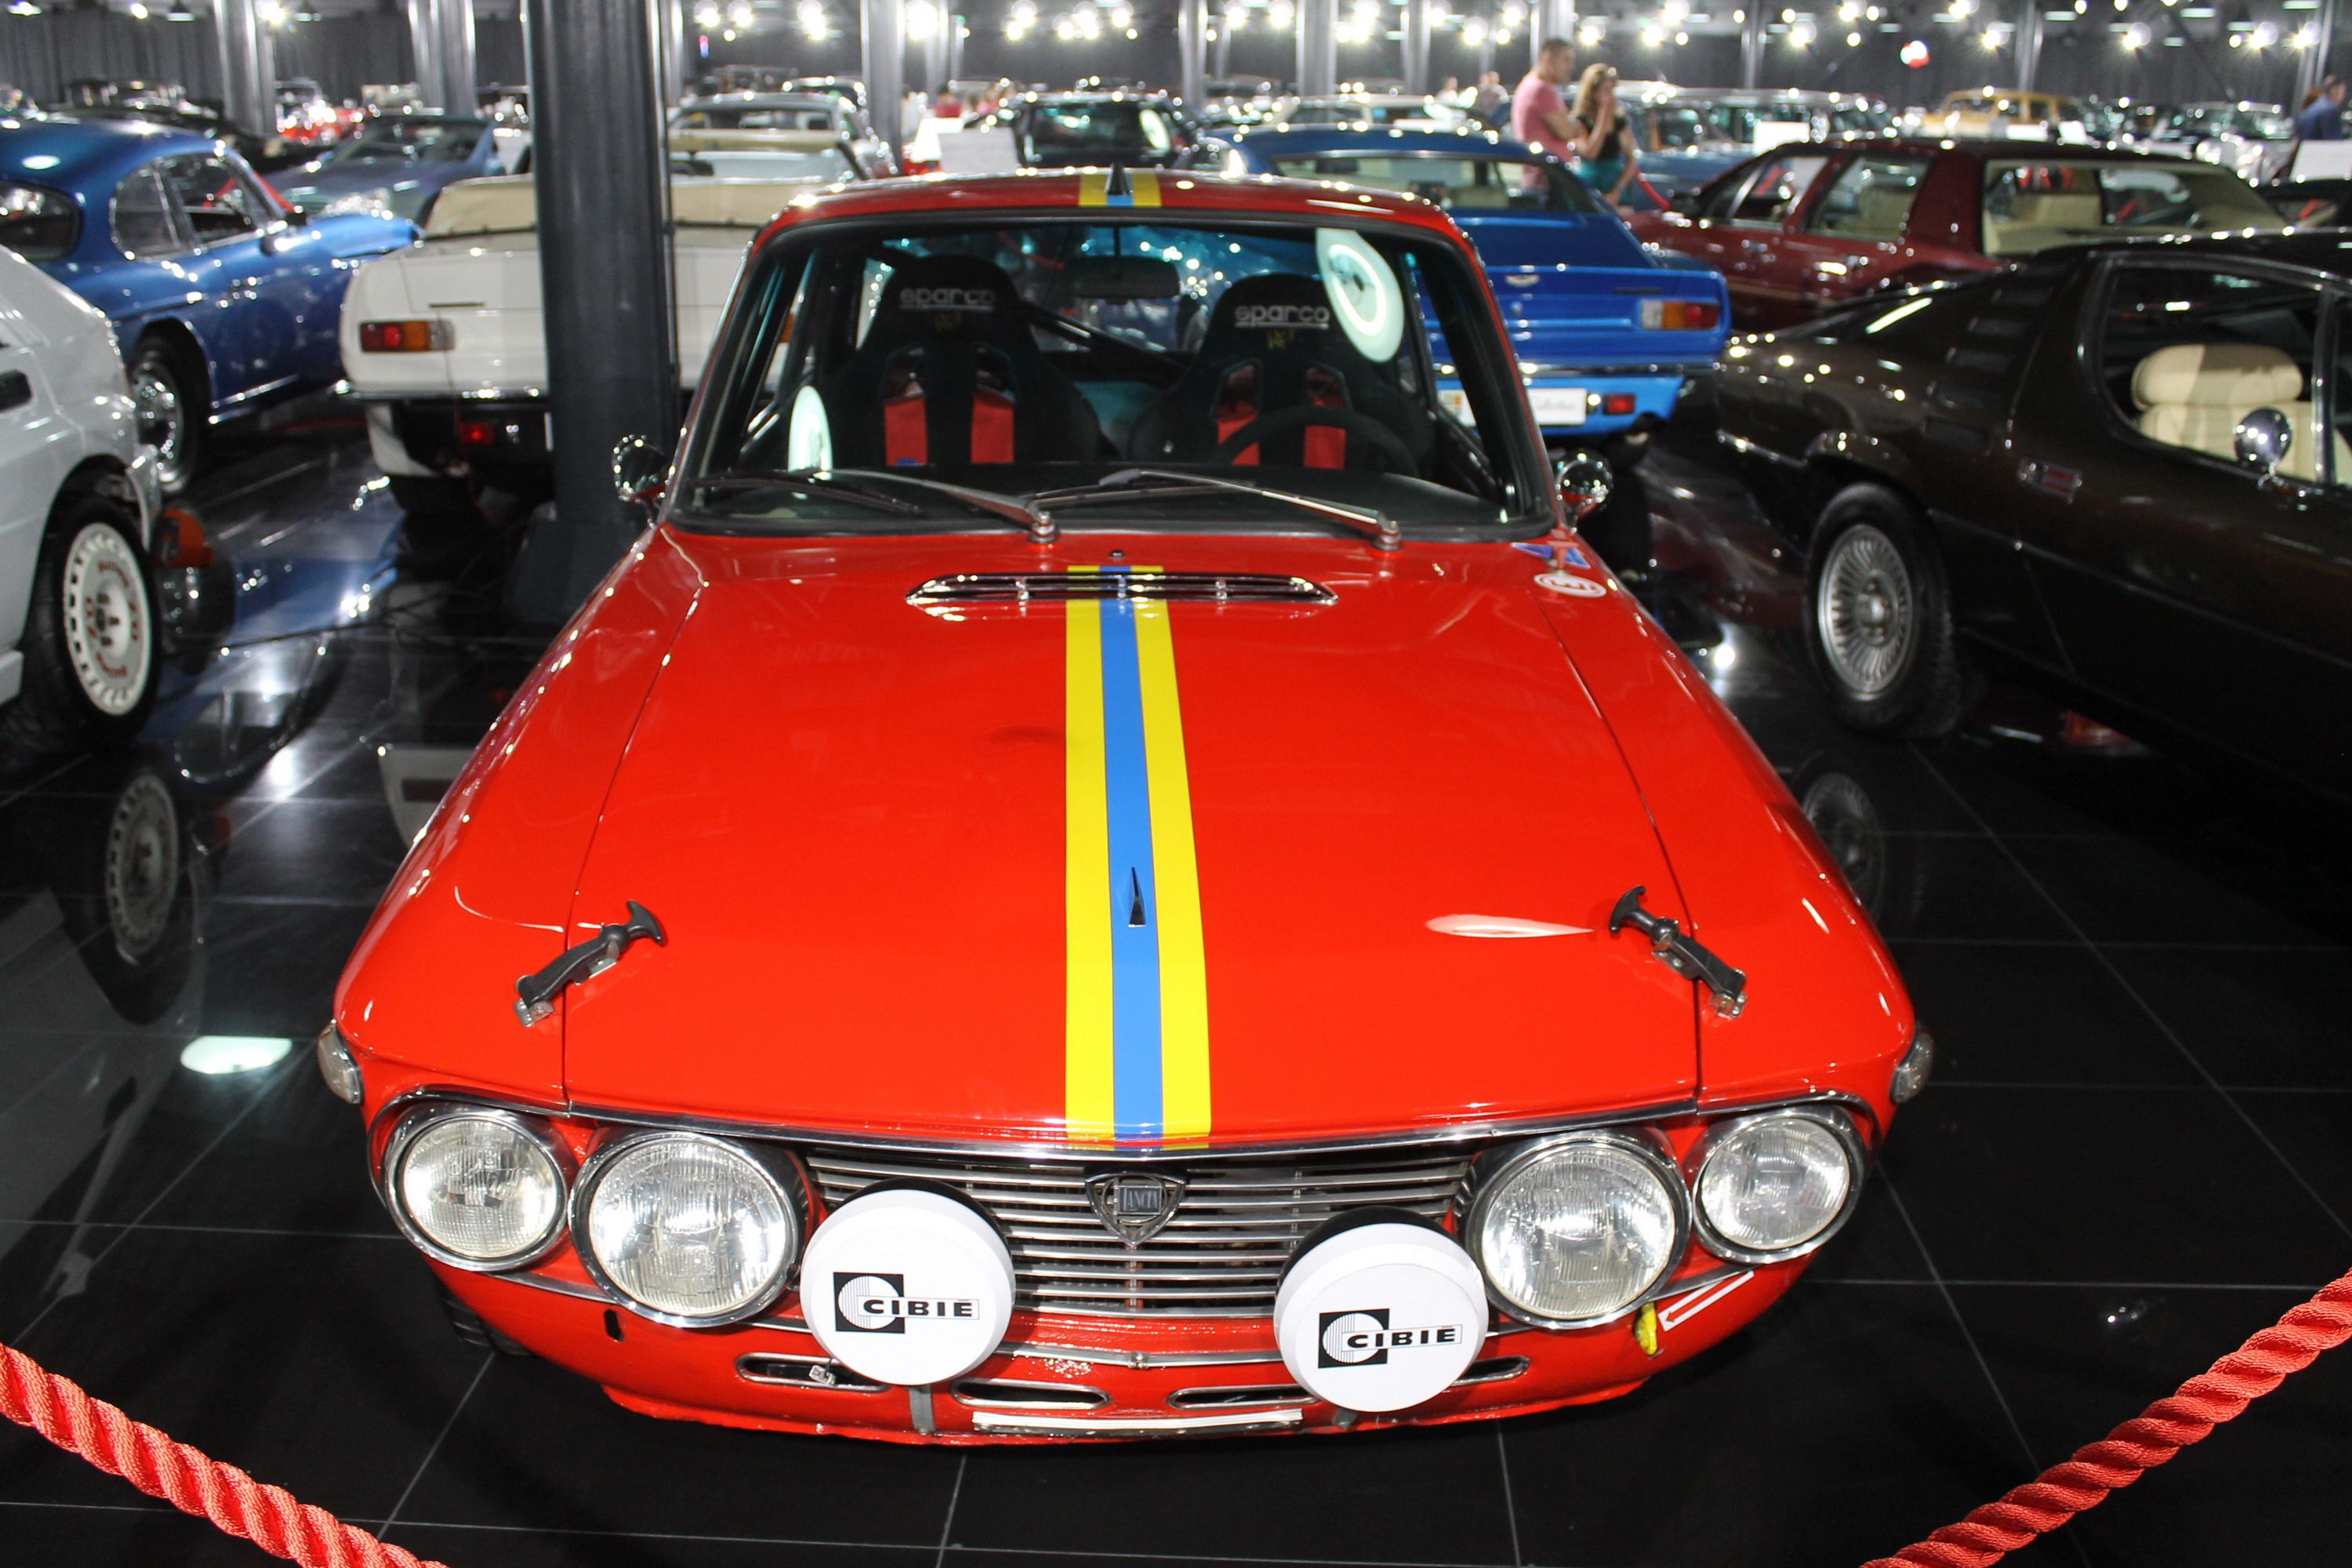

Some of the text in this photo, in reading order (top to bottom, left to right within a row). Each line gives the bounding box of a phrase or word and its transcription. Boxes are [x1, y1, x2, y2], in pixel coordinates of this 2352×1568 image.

[899, 288, 995, 310] sparco
[1235, 305, 1330, 328] sparco
[863, 1299, 973, 1317] CIBIE
[1347, 1328, 1456, 1348] CIBIE
